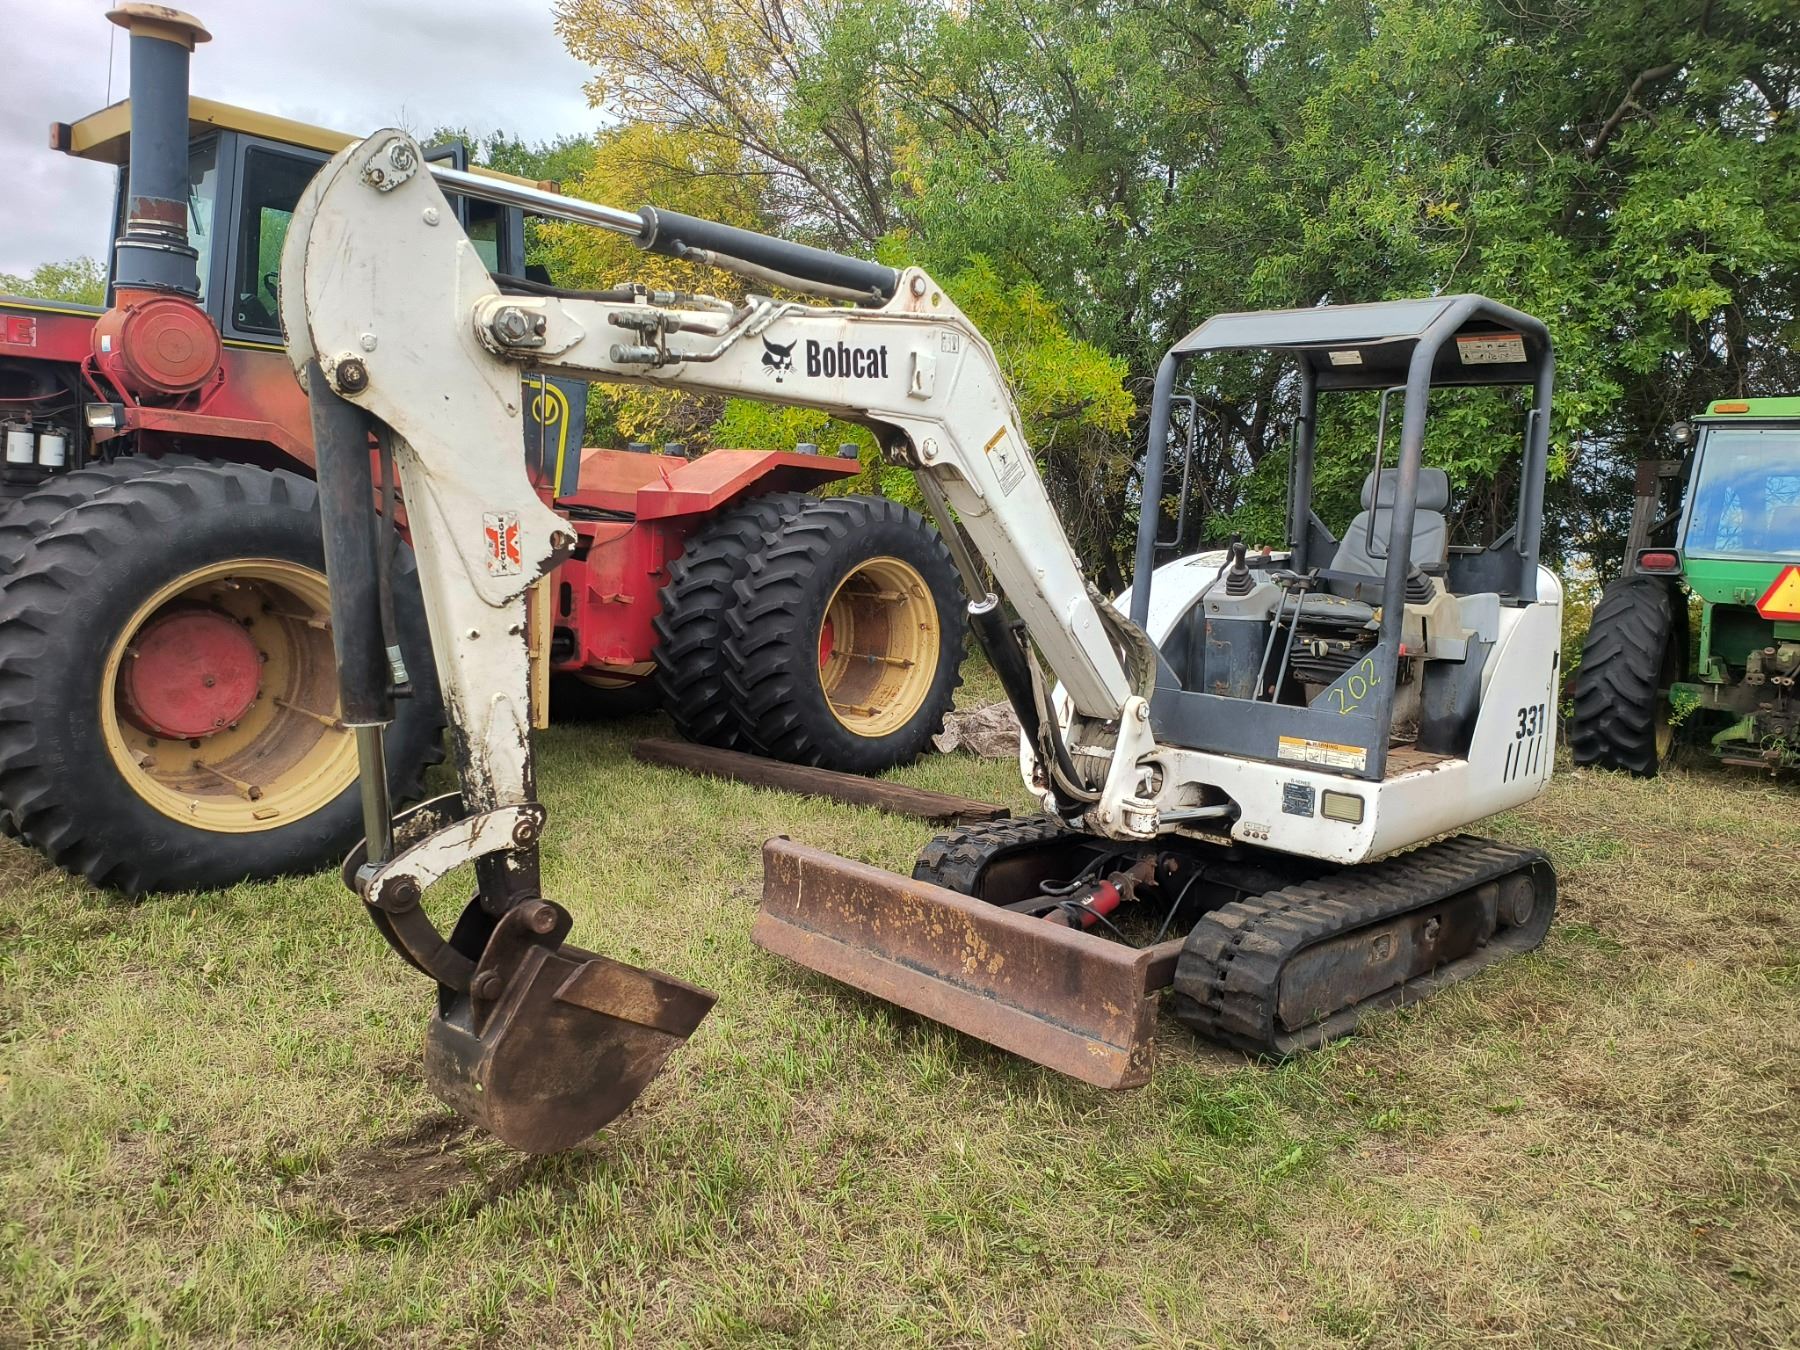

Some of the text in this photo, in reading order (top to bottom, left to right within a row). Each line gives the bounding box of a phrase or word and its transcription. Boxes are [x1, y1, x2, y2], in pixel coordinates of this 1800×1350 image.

[806, 339, 888, 378] Bobcat
[1328, 658, 1381, 715] 202
[1515, 703, 1545, 740] 331
